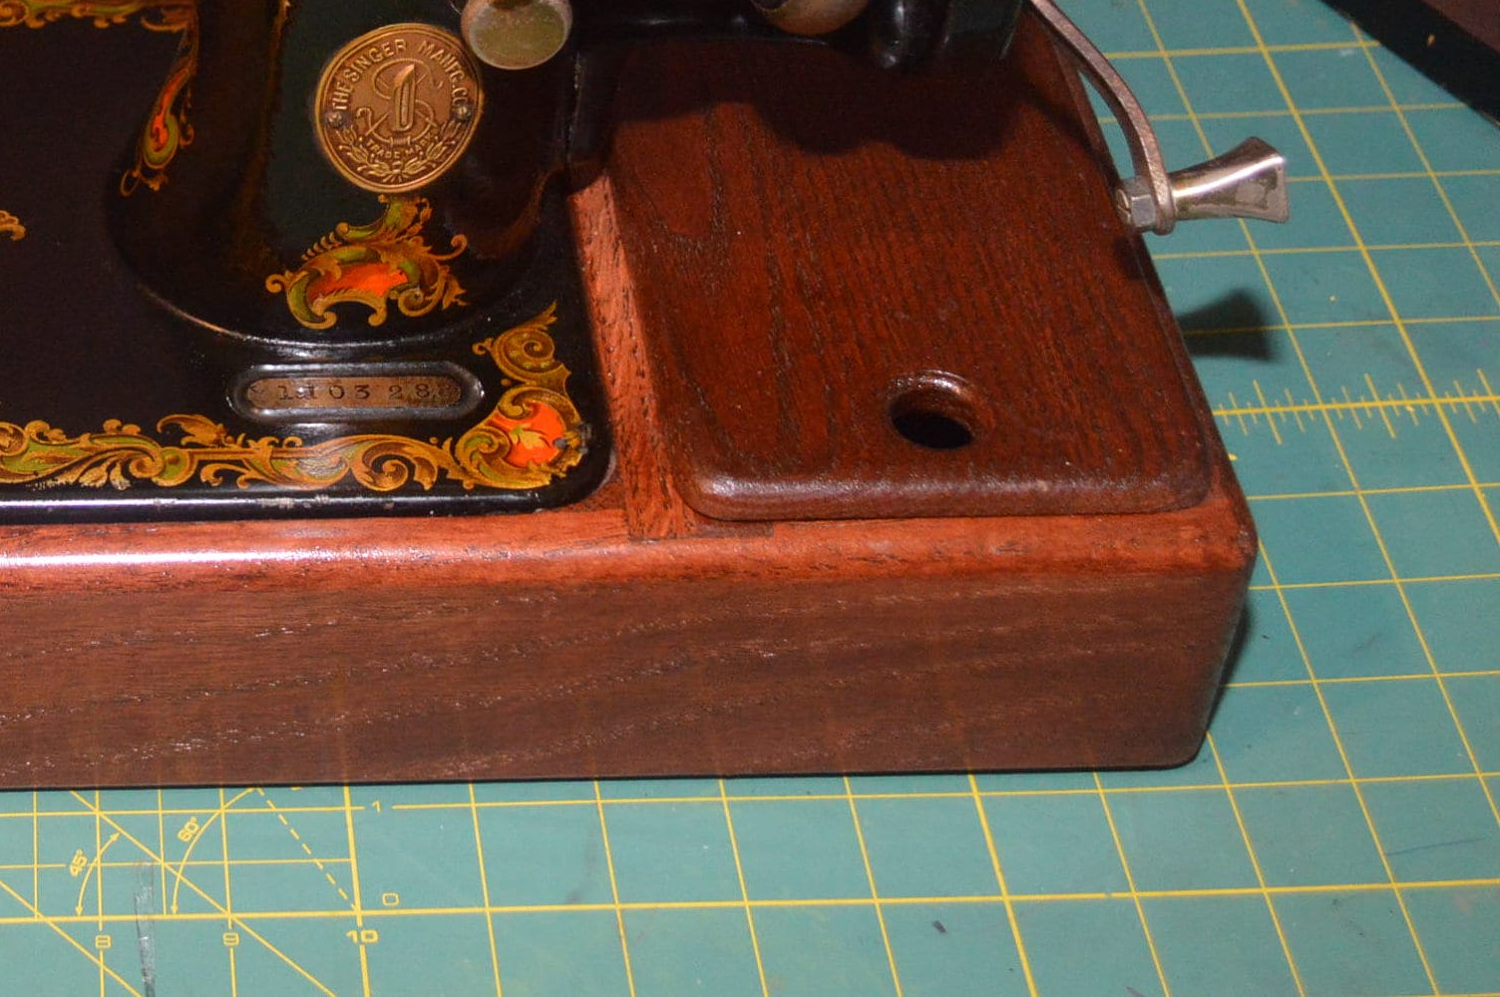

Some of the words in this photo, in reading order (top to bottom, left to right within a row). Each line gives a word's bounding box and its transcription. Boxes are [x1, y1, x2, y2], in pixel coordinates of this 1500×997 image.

[343, 38, 408, 83] SINGER
[332, 81, 355, 111] THE
[95, 934, 112, 949] 8
[222, 931, 240, 947] 9
[345, 928, 380, 944] 10
